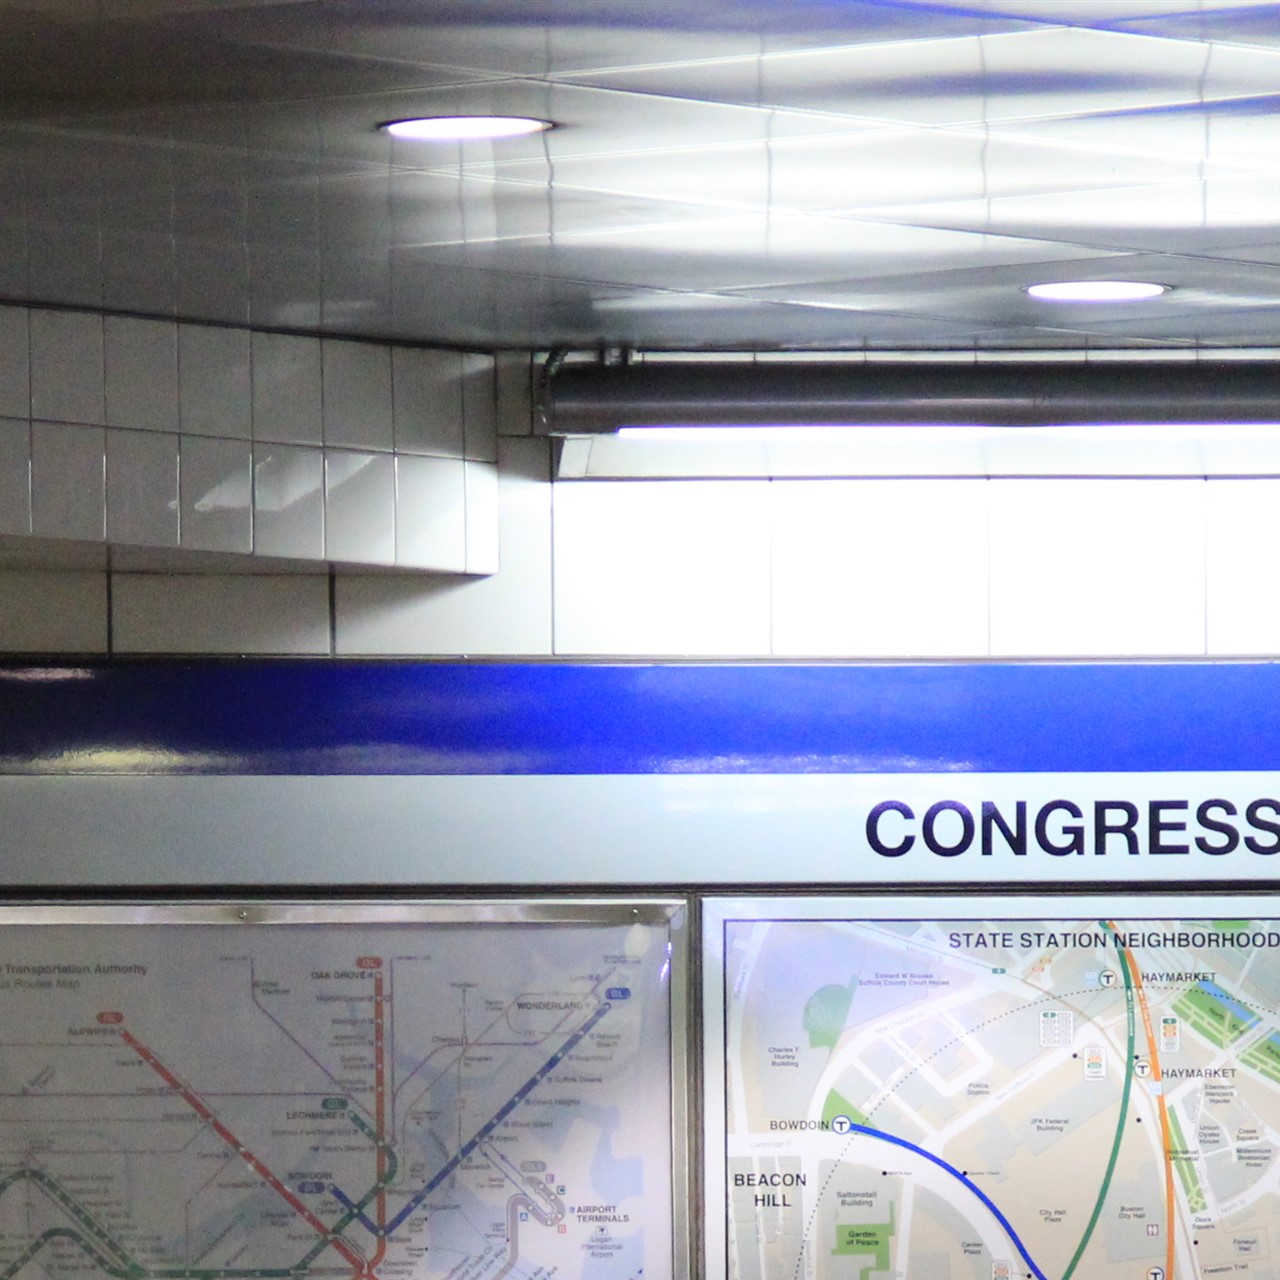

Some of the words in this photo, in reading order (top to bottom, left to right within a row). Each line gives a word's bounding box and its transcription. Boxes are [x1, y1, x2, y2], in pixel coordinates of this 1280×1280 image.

[949, 933, 1013, 948] STATE
[1020, 933, 1107, 948] STATION
[1114, 933, 1280, 948] NEIGHBORHOOD
[5, 965, 89, 976] Transportation
[94, 965, 147, 976] Authority
[1142, 972, 1216, 982] HAYMARKET
[517, 1002, 583, 1010] WONDERLAND
[1161, 1069, 1236, 1078] HAYMARKET
[287, 1112, 337, 1120] LECHMERE
[770, 1119, 829, 1130] BOWDOIN
[734, 1174, 806, 1187] BEACON
[754, 1195, 792, 1207] HILL
[577, 1206, 616, 1214] AIRPORT
